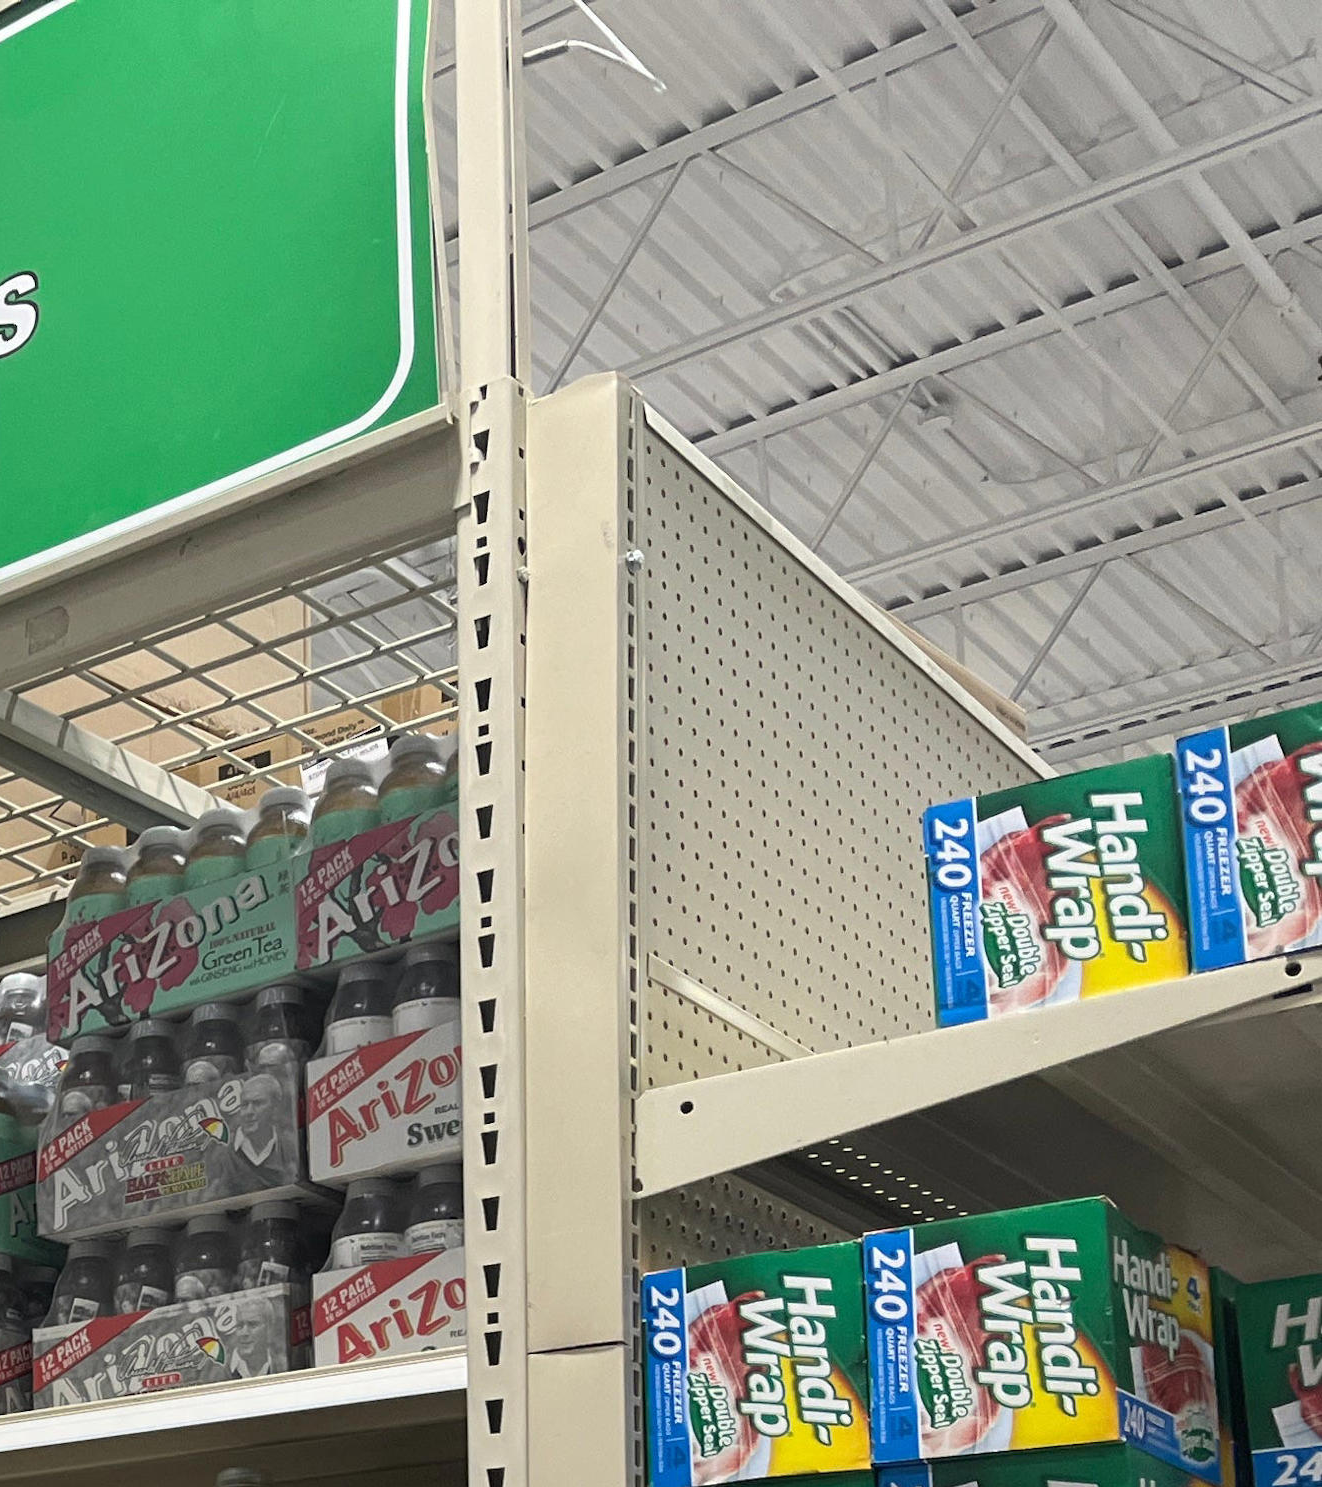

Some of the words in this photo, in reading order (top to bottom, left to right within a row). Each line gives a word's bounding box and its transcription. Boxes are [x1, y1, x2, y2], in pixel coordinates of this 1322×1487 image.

[1185, 749, 1227, 823] 240
[933, 818, 972, 887] 240
[1088, 791, 1170, 962] Handi-
[1216, 828, 1230, 896] FREEZER
[1238, 838, 1267, 890] Zipper
[1257, 891, 1277, 927] Seal
[1264, 850, 1299, 914] Double
[1043, 818, 1102, 960] Wrap
[54, 947, 71, 971] 12
[70, 925, 102, 958] PACK
[63, 872, 272, 1036] AriZona
[202, 946, 251, 972] Green
[253, 937, 284, 960] Tea
[960, 893, 975, 958] FREEZER
[980, 902, 1010, 950] Zipper
[1000, 950, 1019, 988] Seal
[1009, 912, 1036, 975] Double
[313, 1086, 327, 1109] 12
[327, 1057, 364, 1098] PACK
[41, 1143, 58, 1167] 12
[56, 1116, 92, 1155] PACK
[872, 1247, 908, 1320] 240
[1111, 1236, 1181, 1294] Handi-
[650, 1288, 682, 1355] 240
[933, 1324, 950, 1353] new!
[978, 1261, 1032, 1409] Wrap
[1025, 1237, 1100, 1416] Handi-
[1122, 1289, 1180, 1361] Wrap
[671, 1361, 681, 1424] FREEZER
[739, 1298, 790, 1437] Wrap
[782, 1275, 853, 1445] Handi-
[896, 1327, 909, 1393] FREEZER
[915, 1339, 944, 1392] Zipper
[932, 1392, 951, 1428] Seal
[941, 1353, 972, 1417] Double
[688, 1374, 714, 1423] Zipper
[701, 1423, 718, 1457] Seal
[710, 1385, 737, 1447] Double
